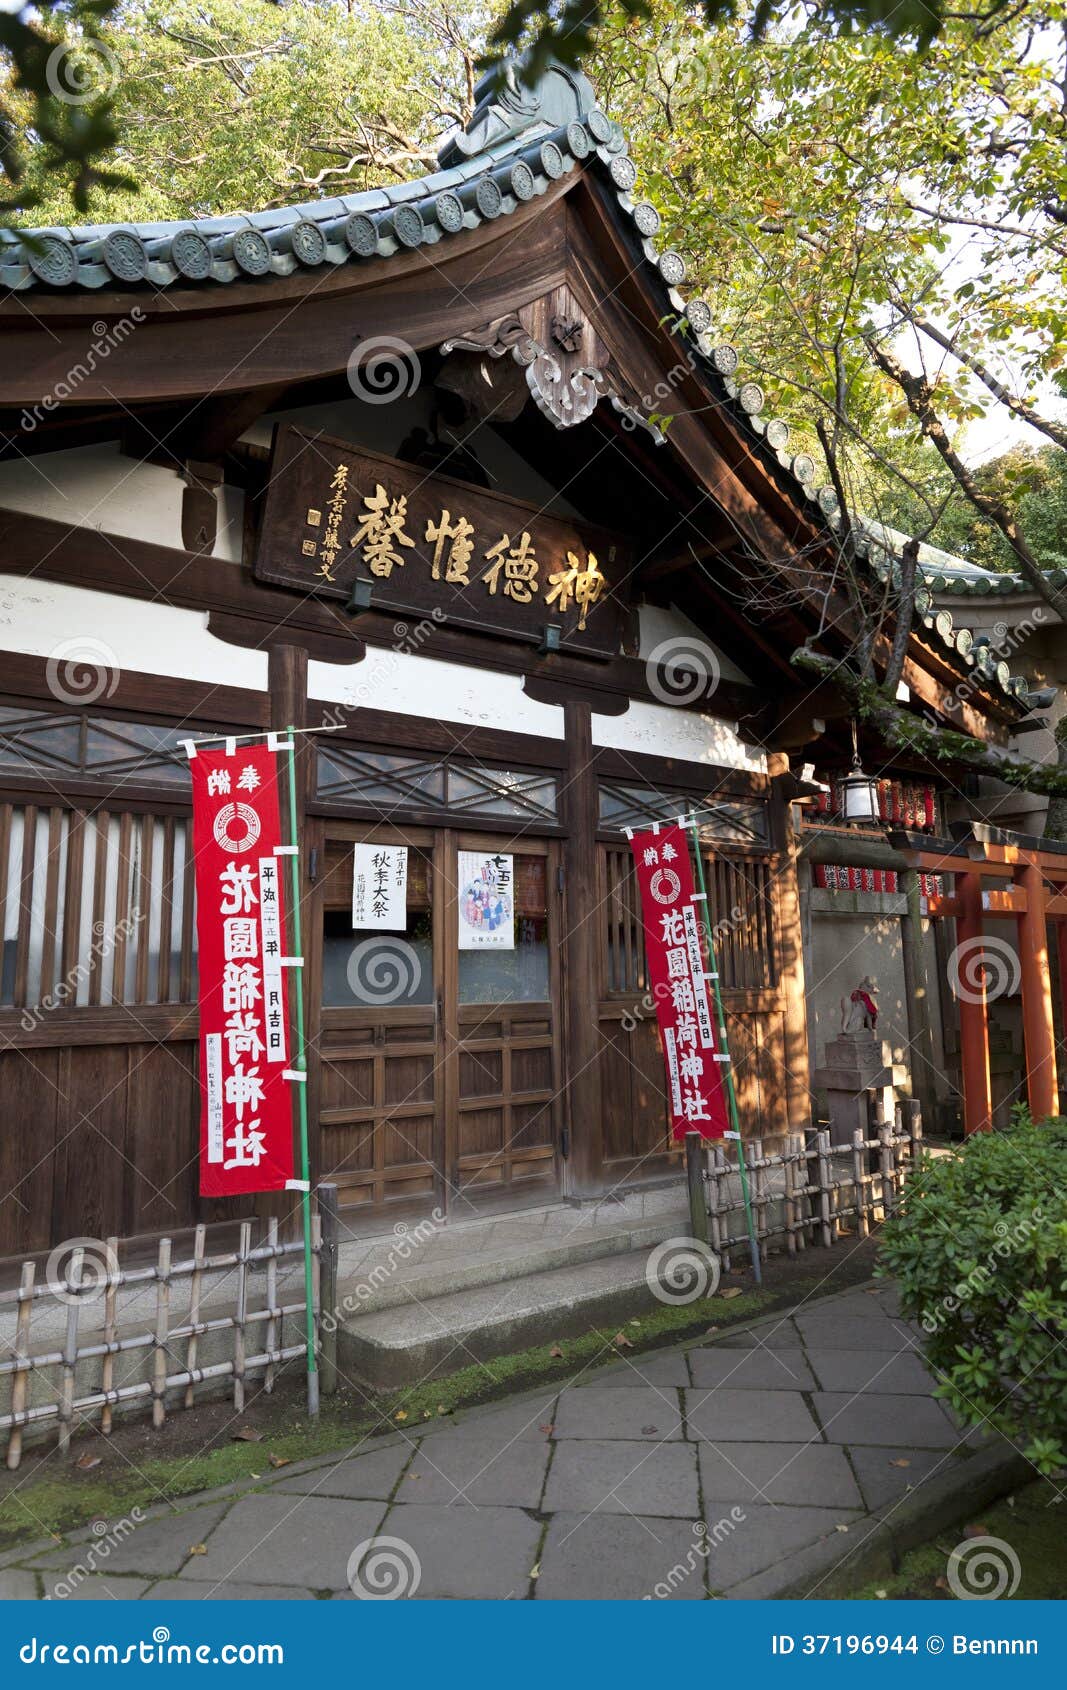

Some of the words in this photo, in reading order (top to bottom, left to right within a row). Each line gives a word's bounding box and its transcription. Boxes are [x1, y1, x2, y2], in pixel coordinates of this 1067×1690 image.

[491, 855, 511, 894] 七五三
[643, 842, 679, 867] 奉納
[371, 850, 392, 918] 秋季大祭
[659, 908, 712, 1122] 花園稲荷神社
